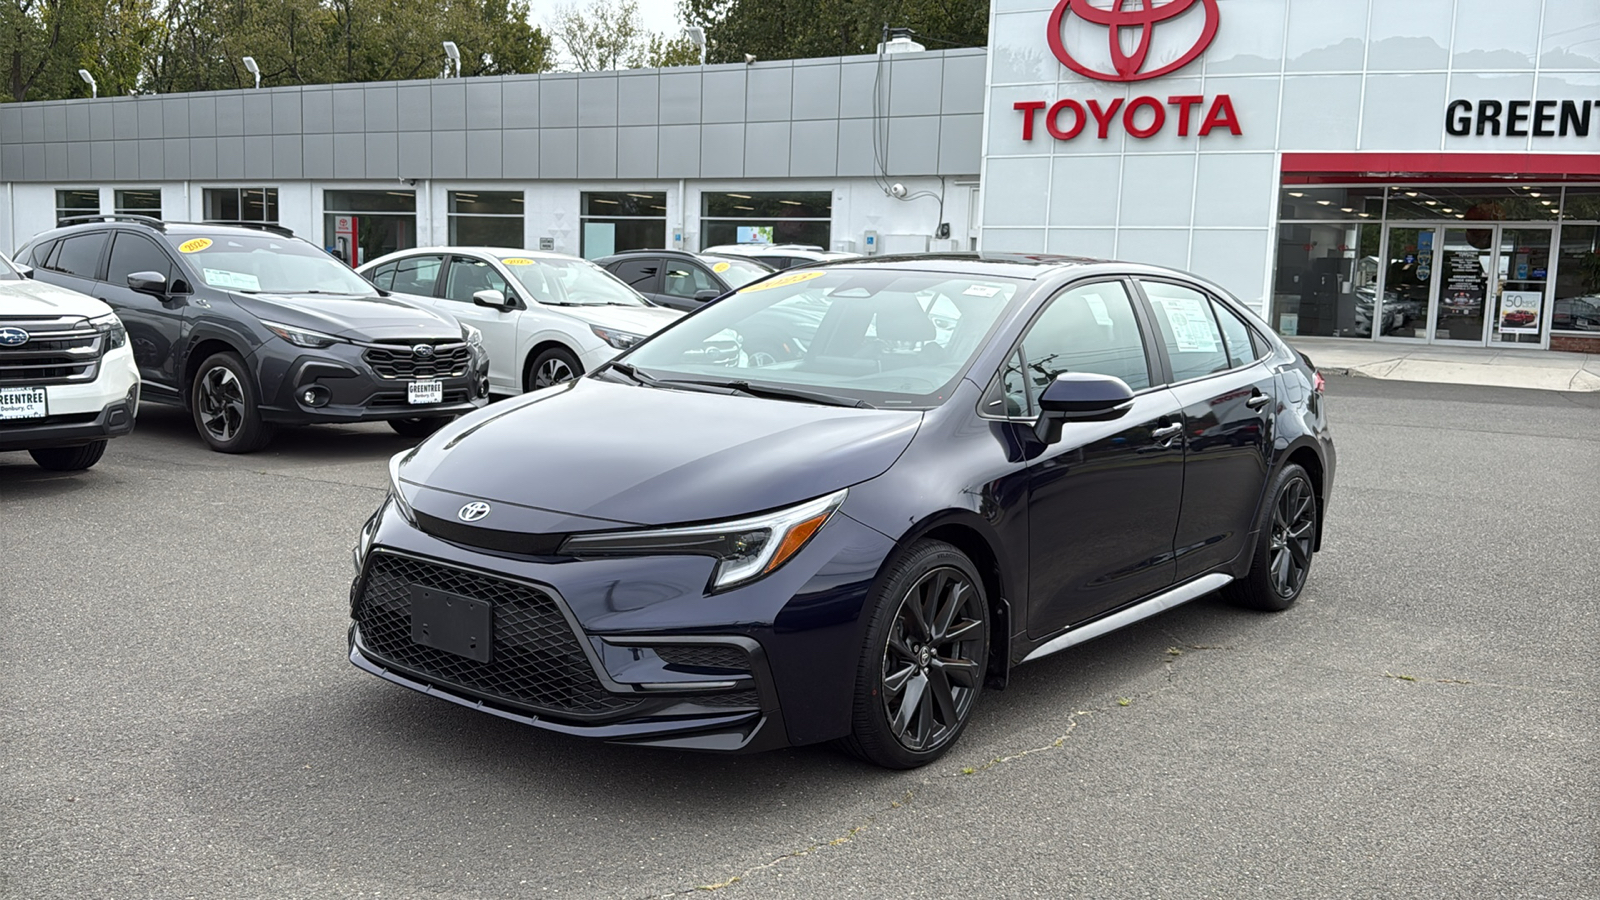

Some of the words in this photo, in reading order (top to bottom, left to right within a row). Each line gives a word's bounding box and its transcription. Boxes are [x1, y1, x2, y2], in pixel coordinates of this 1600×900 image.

[1013, 95, 1242, 141] TOYOTA
[184, 239, 208, 252] 2024
[1505, 295, 1523, 308] 50
[410, 383, 441, 394] GREENTREE
